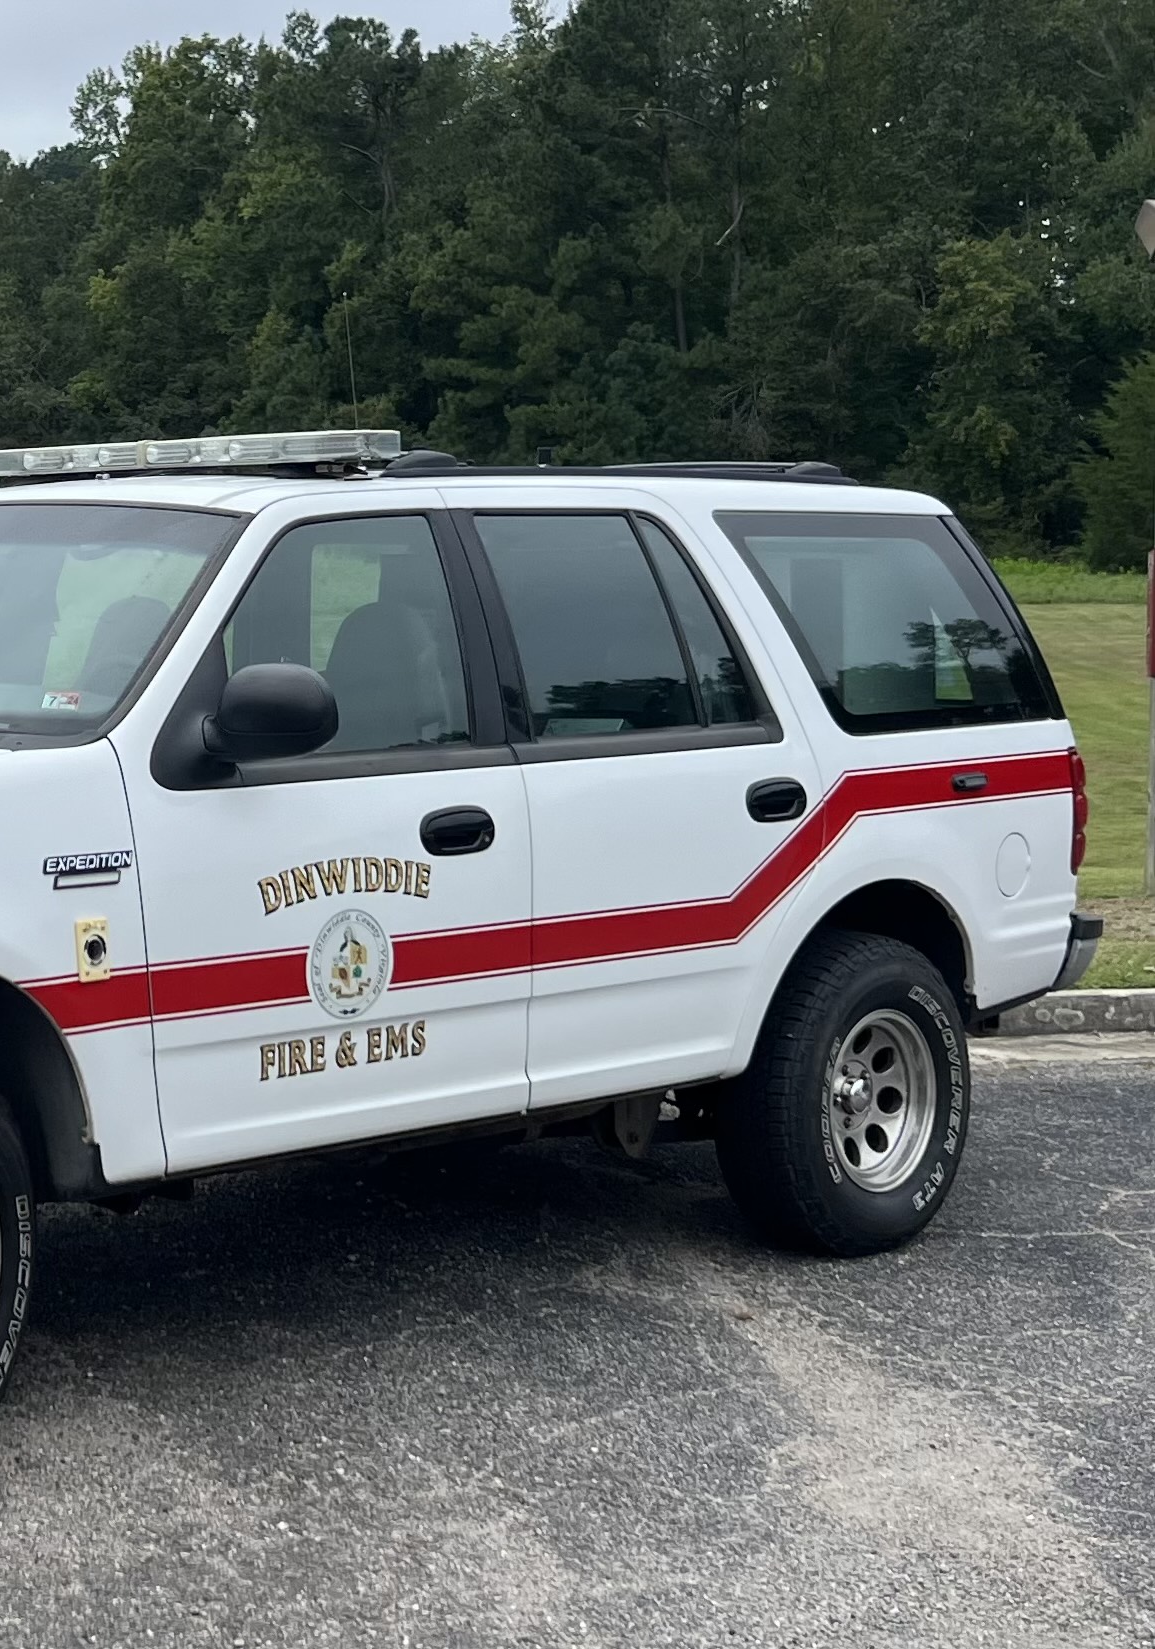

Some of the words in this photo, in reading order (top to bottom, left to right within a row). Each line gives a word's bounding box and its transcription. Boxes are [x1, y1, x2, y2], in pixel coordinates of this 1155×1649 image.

[48, 695, 58, 707] 7
[45, 851, 132, 873] EXPEDITION
[257, 856, 432, 916] DINWIDDIE
[259, 1035, 327, 1082] FIRE
[335, 1030, 357, 1068] &
[366, 1020, 427, 1064] EMS
[908, 986, 963, 1155] DISCOVERER
